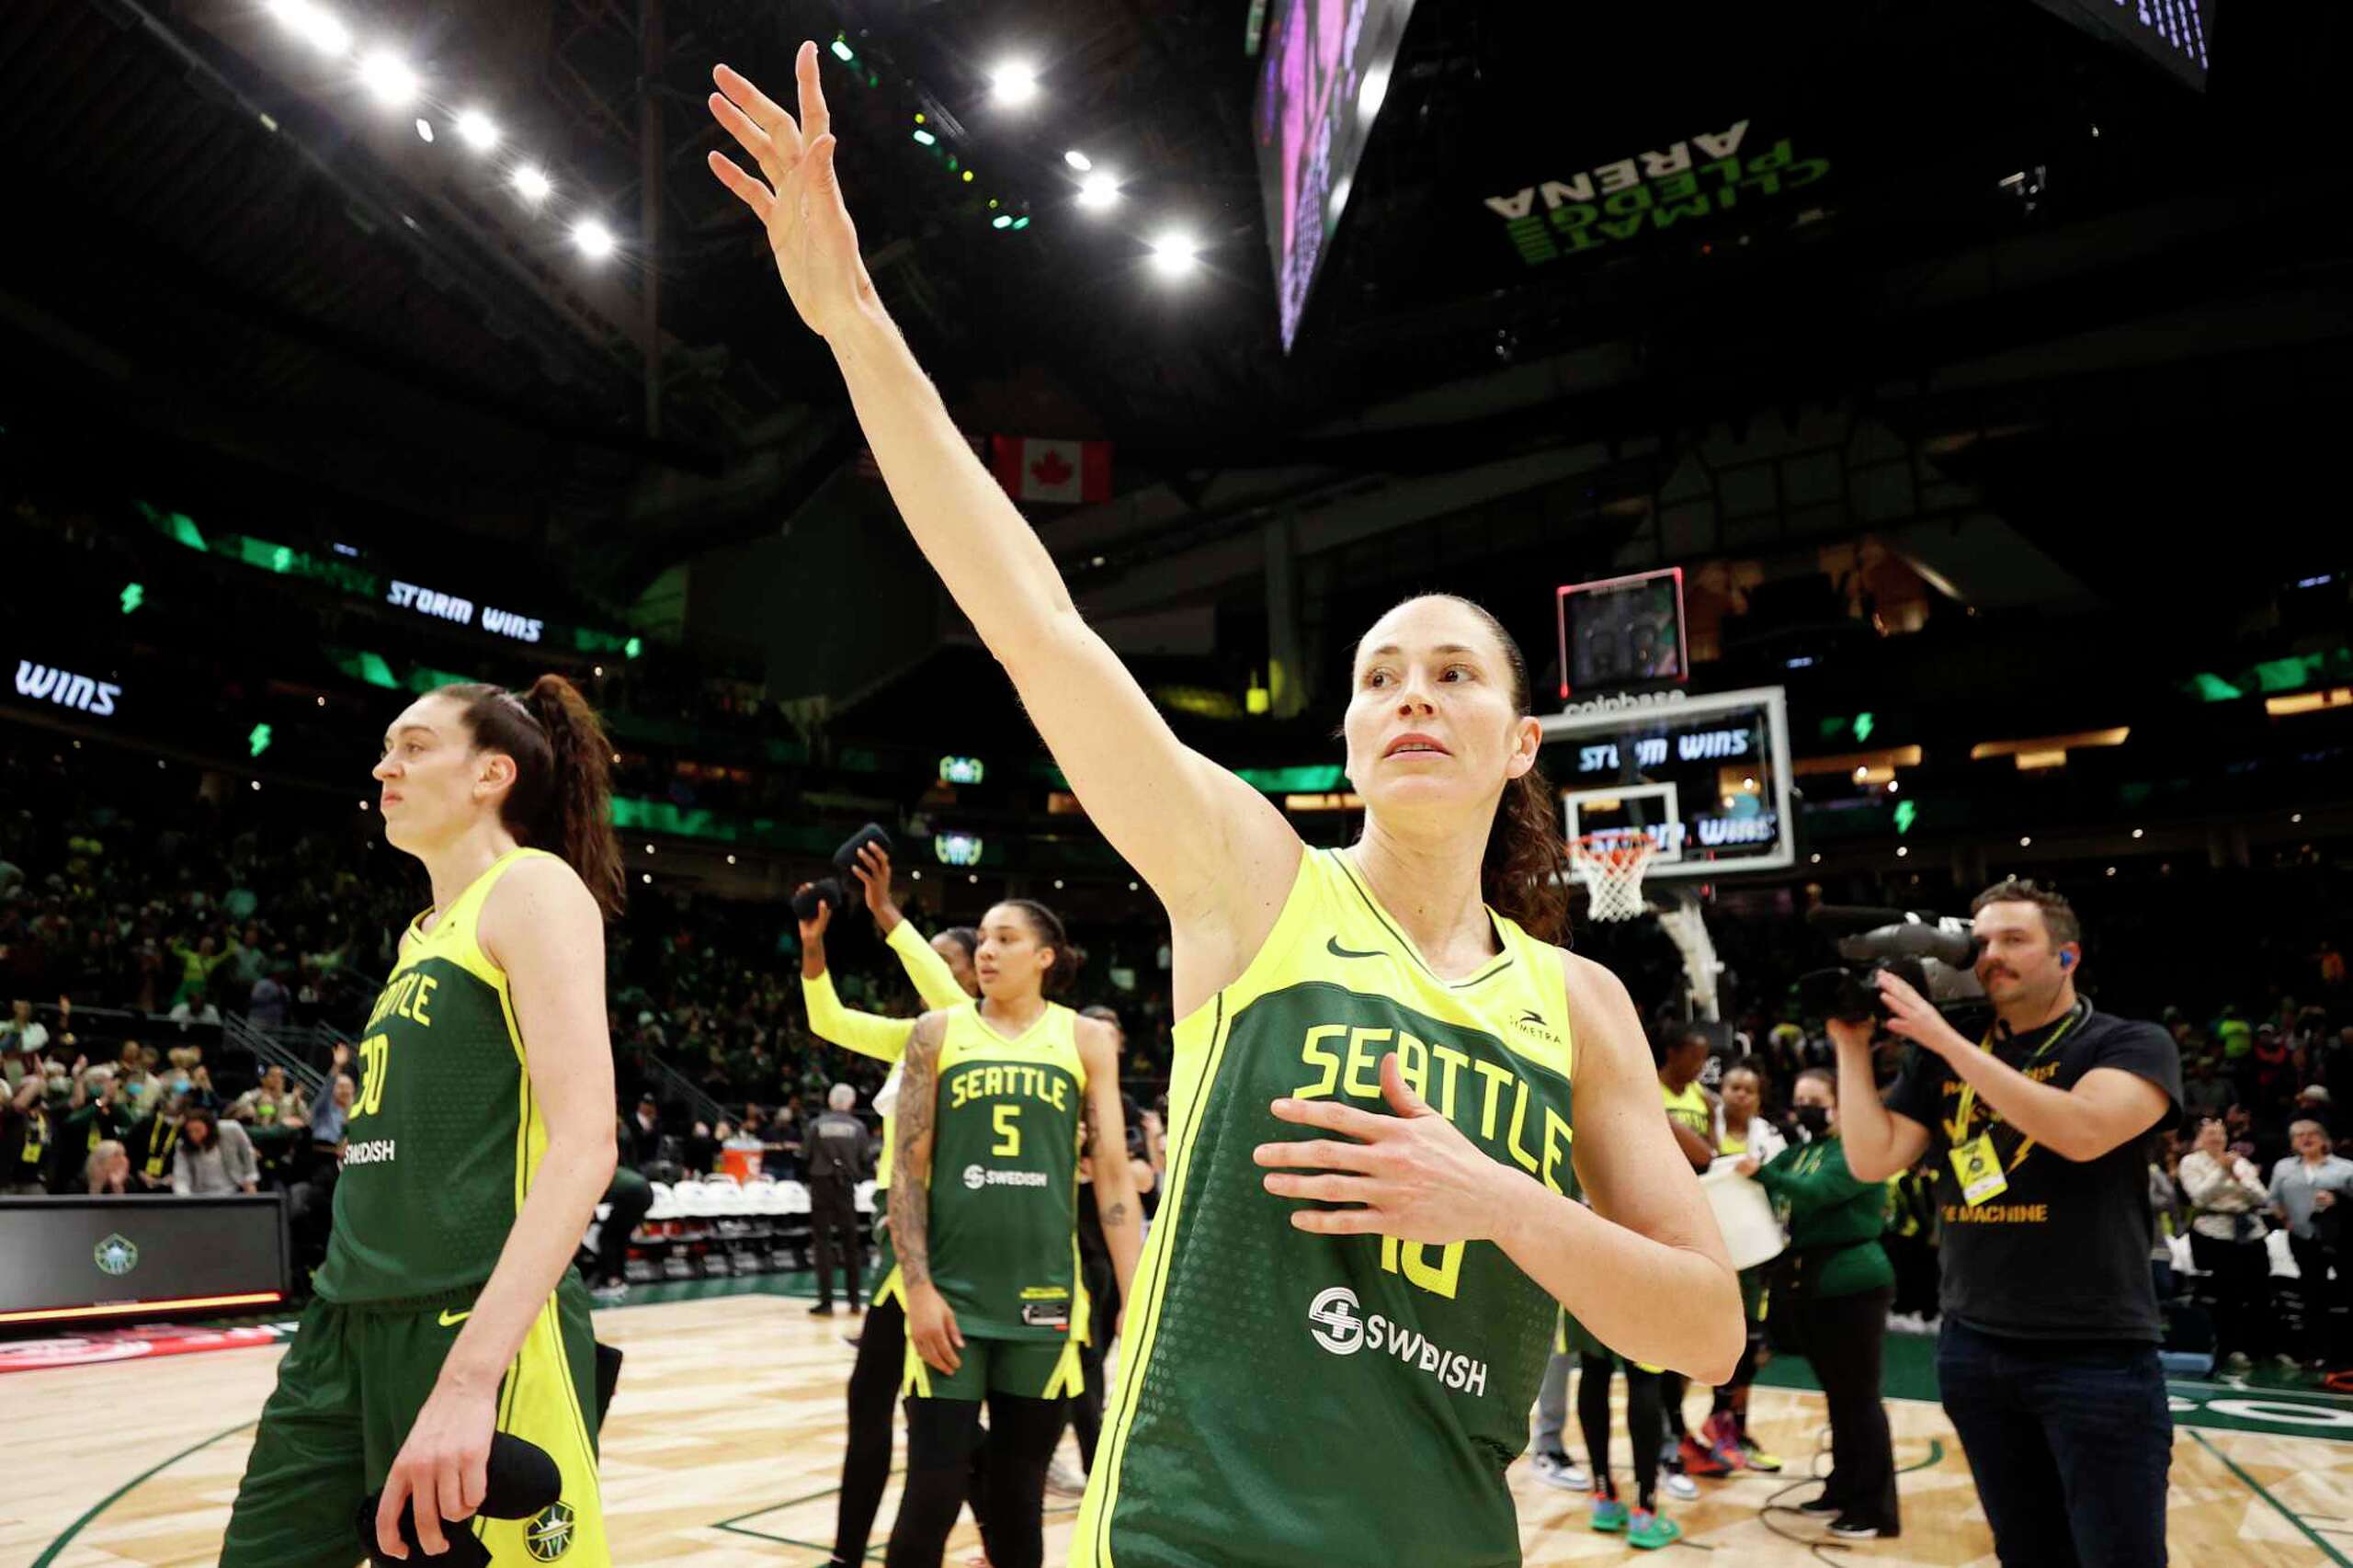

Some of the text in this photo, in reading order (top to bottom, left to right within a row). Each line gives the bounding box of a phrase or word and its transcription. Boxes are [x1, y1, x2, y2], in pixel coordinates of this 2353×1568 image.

[1483, 119, 1750, 220] ARENA
[386, 579, 544, 642] STORM WINS
[15, 658, 122, 717] WINS
[1578, 729, 1750, 772] STM WINS
[348, 1033, 390, 1119] 30
[951, 1065, 1068, 1112] SEATTLE
[992, 1104, 1021, 1156] 5
[1291, 1024, 1574, 1196] SEATTLE
[985, 1169, 1048, 1187] SWEDISH
